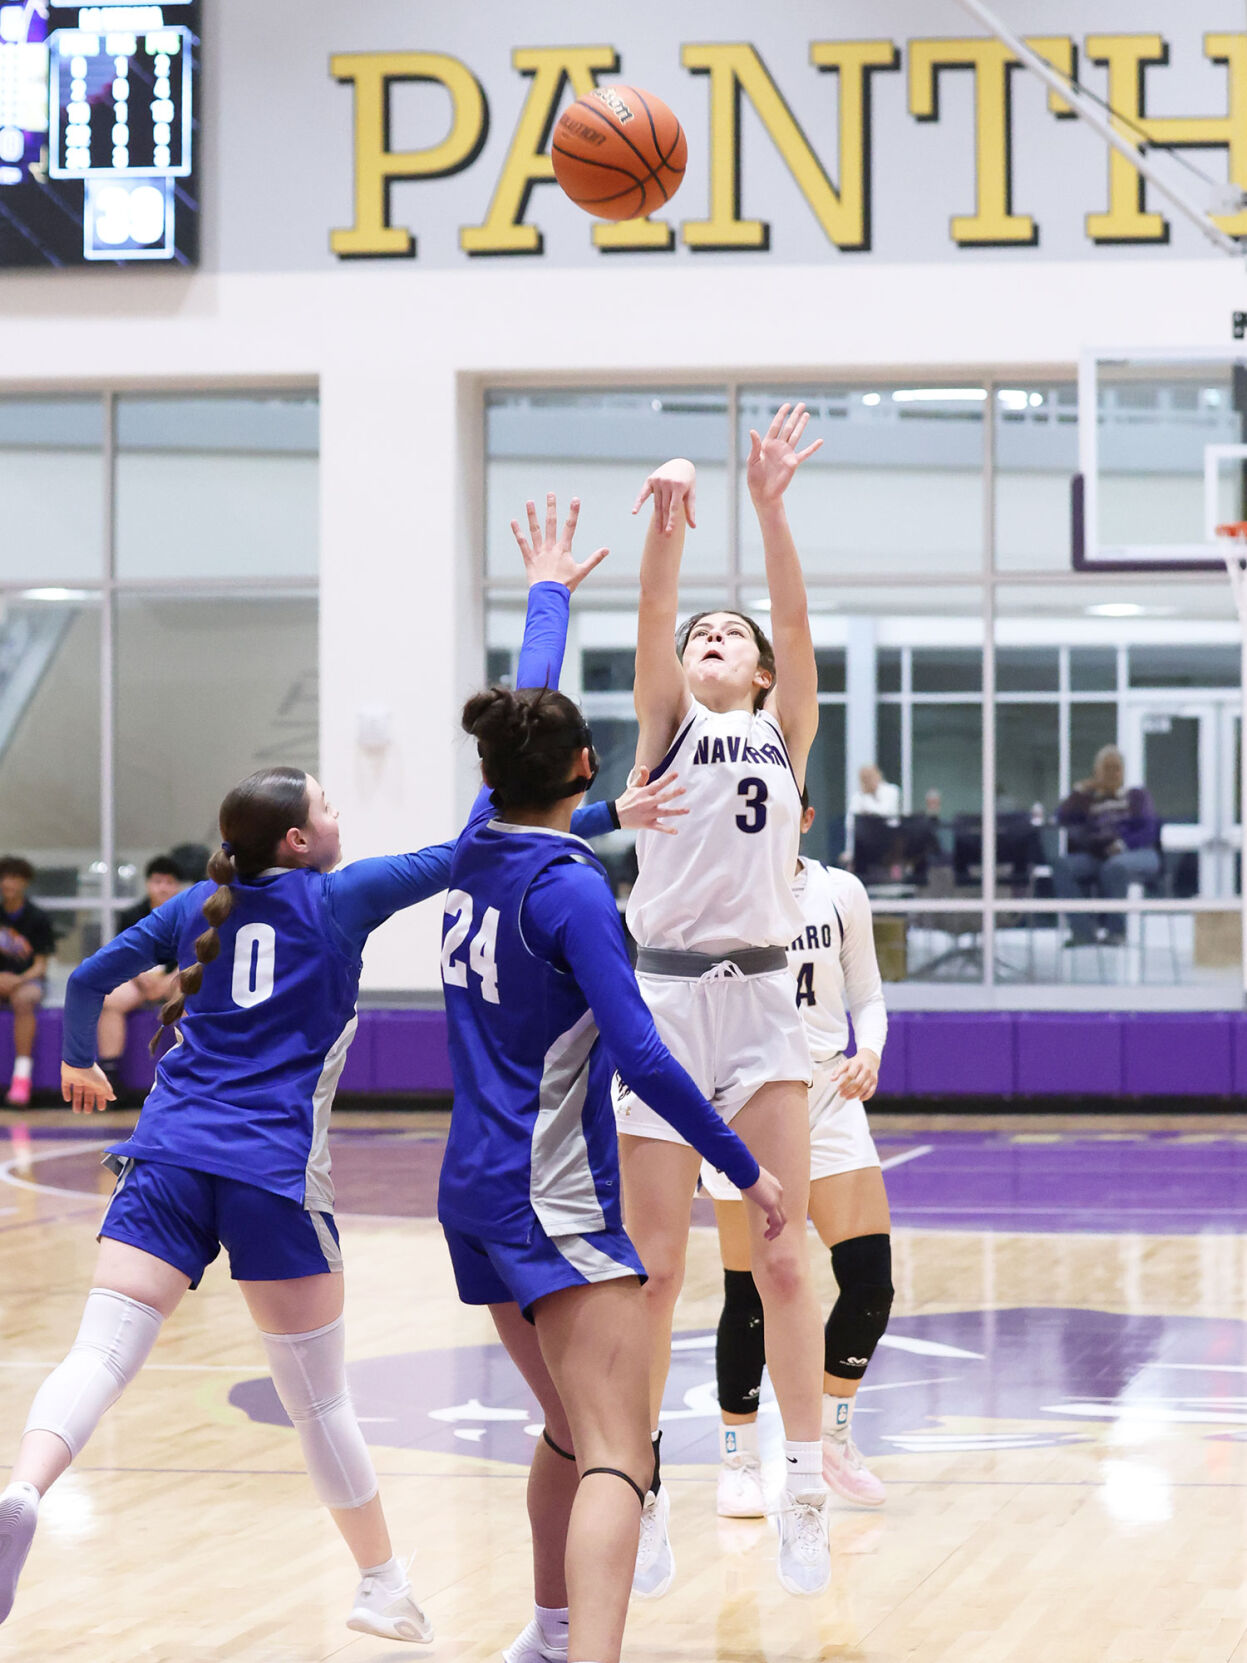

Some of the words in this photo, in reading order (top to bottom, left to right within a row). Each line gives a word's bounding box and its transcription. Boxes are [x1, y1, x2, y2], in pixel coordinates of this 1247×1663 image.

[329, 34, 1247, 258] PANTH
[735, 777, 768, 834] 3
[231, 922, 276, 1009] 0
[441, 888, 501, 1005] 24
